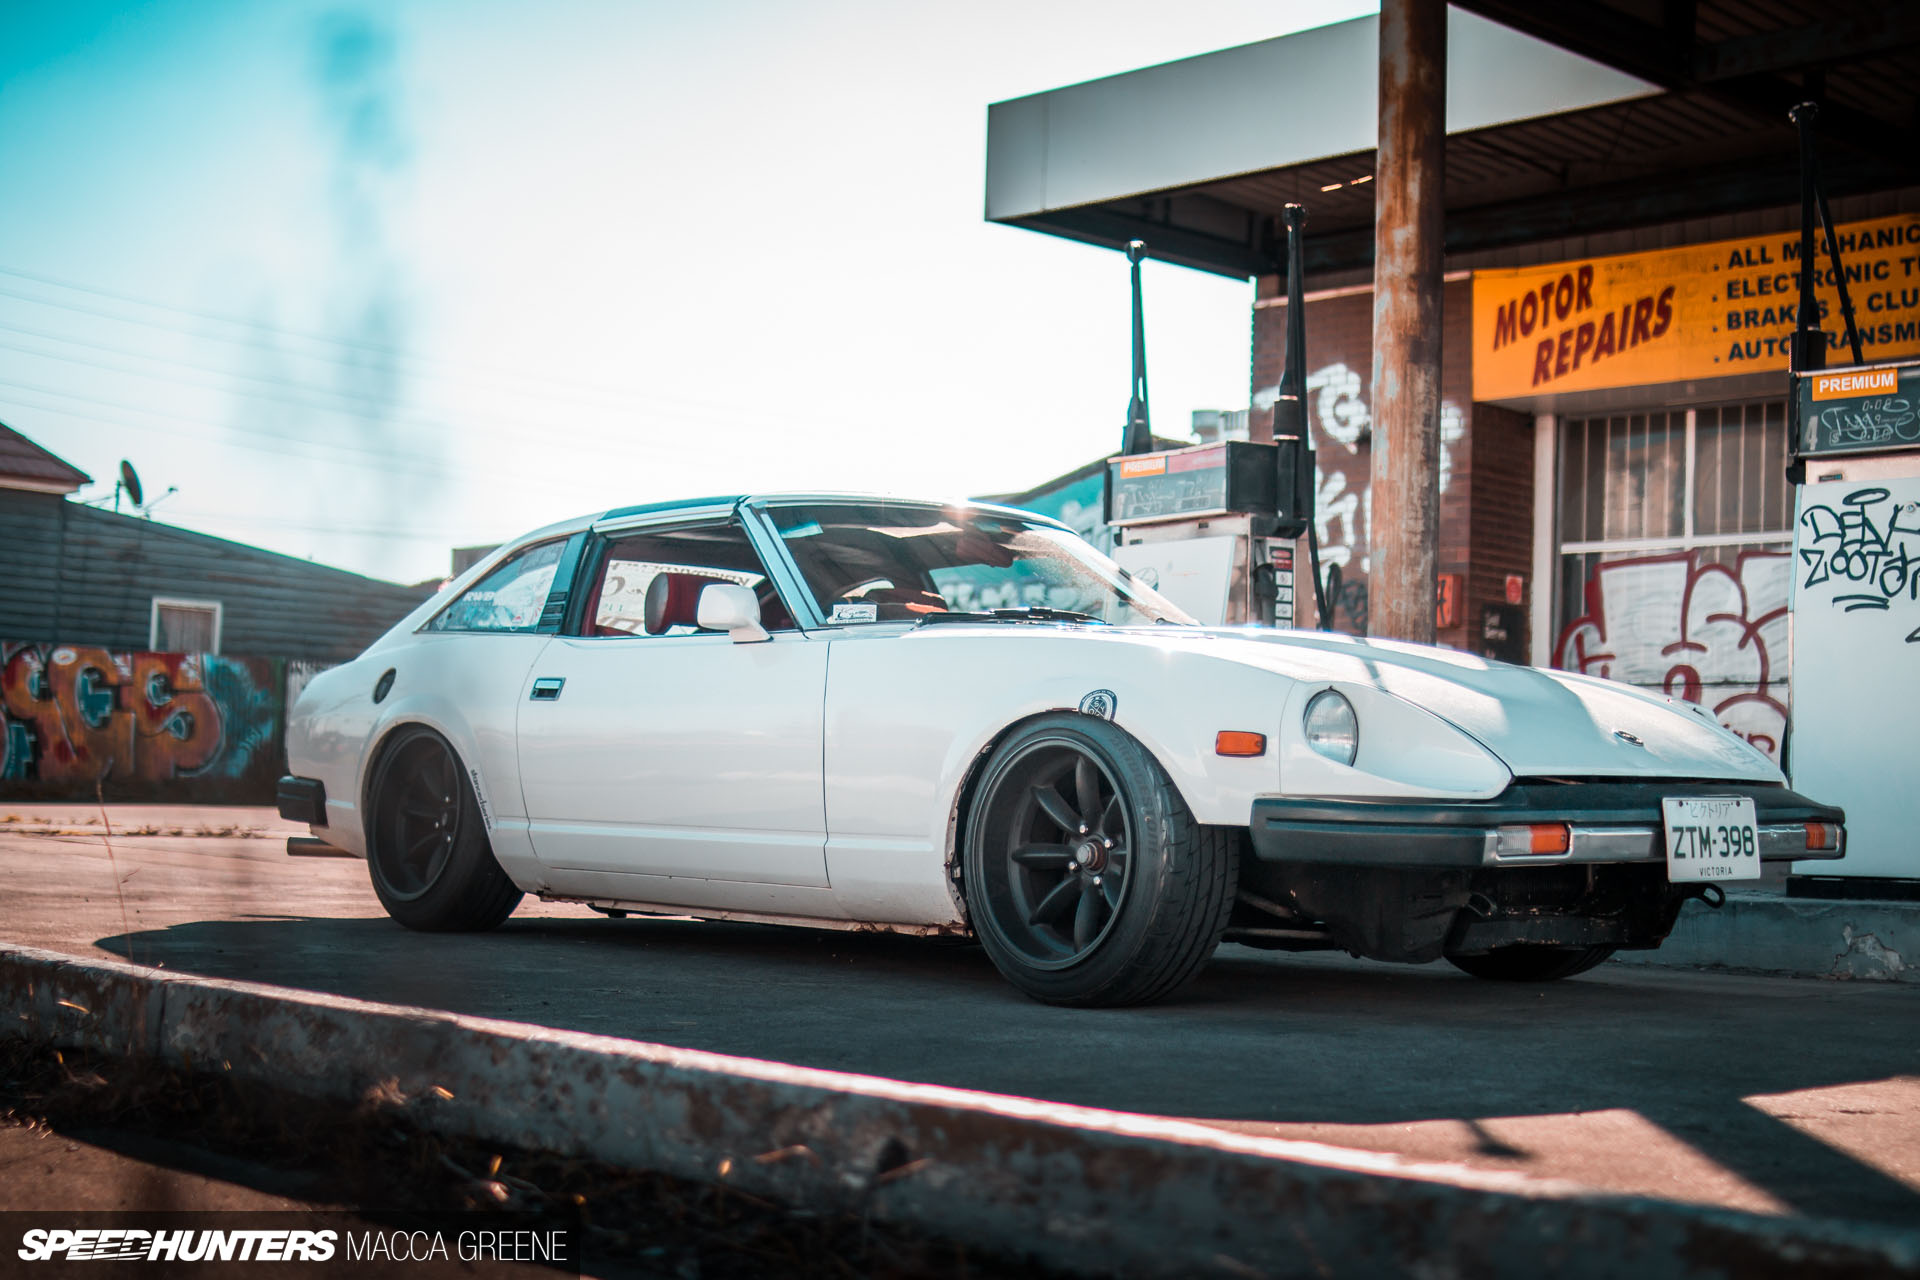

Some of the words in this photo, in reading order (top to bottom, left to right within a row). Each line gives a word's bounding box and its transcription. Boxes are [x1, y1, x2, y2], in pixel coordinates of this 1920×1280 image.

[1728, 245, 1774, 270] ALL
[1899, 256, 1920, 277] T
[1493, 265, 1594, 351] MOTOR
[1727, 299, 1829, 331] BRAKS
[1866, 288, 1919, 313] CLU
[1532, 285, 1676, 388] REPAIRS
[1825, 321, 1920, 350] RANSM
[1818, 373, 1895, 393] PREMIUM
[1699, 866, 1733, 877] VICTORIA
